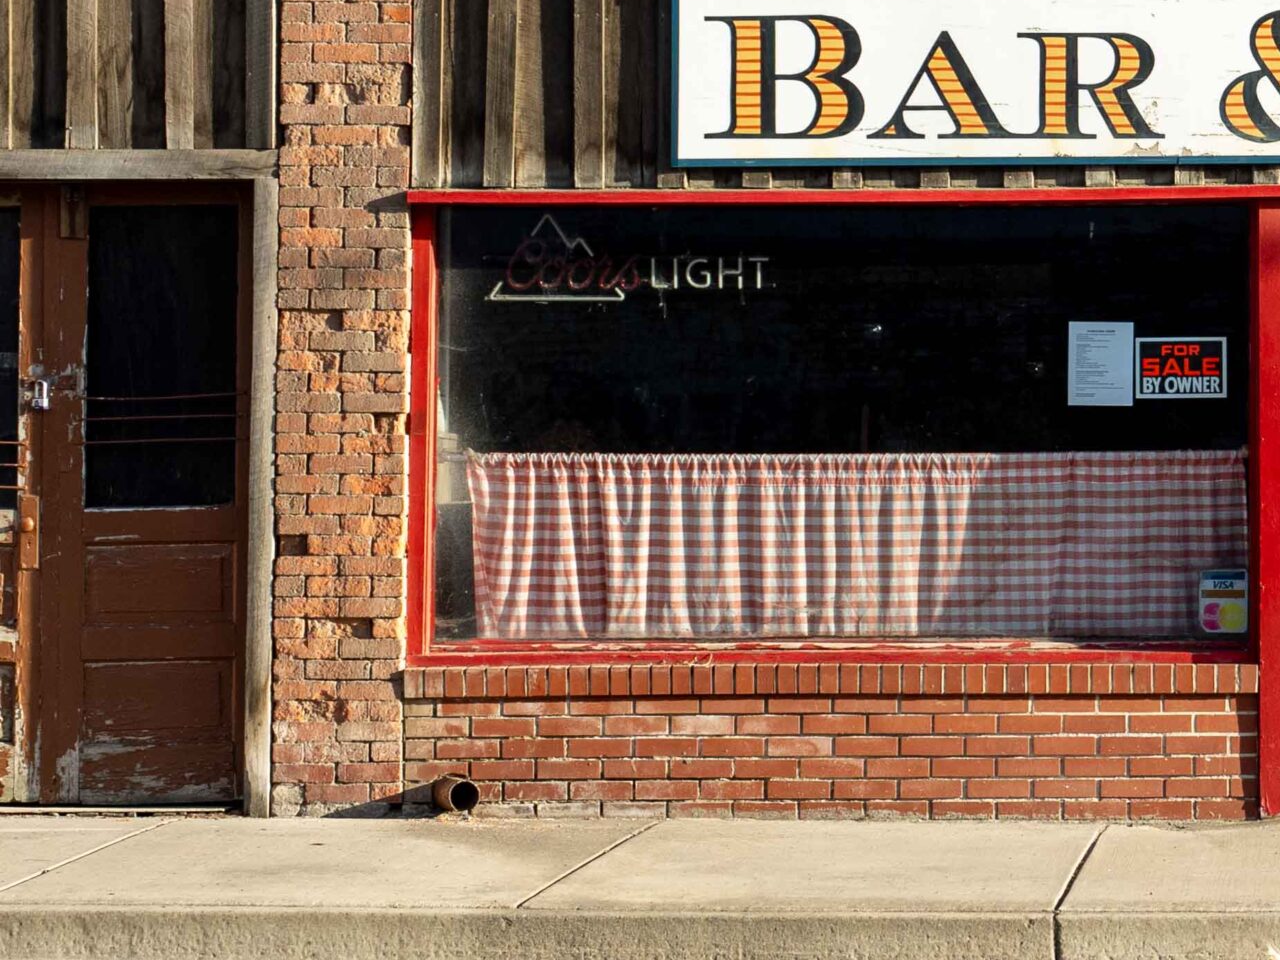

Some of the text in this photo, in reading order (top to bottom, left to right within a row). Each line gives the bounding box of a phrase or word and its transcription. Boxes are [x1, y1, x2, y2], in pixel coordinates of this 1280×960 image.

[703, 13, 1167, 140] BAR
[506, 237, 770, 290] Coors LIGHT
[1160, 344, 1200, 357] FOR
[1141, 357, 1221, 377] SALE
[1142, 376, 1221, 394] BY OWNER
[1212, 580, 1235, 589] VISA
